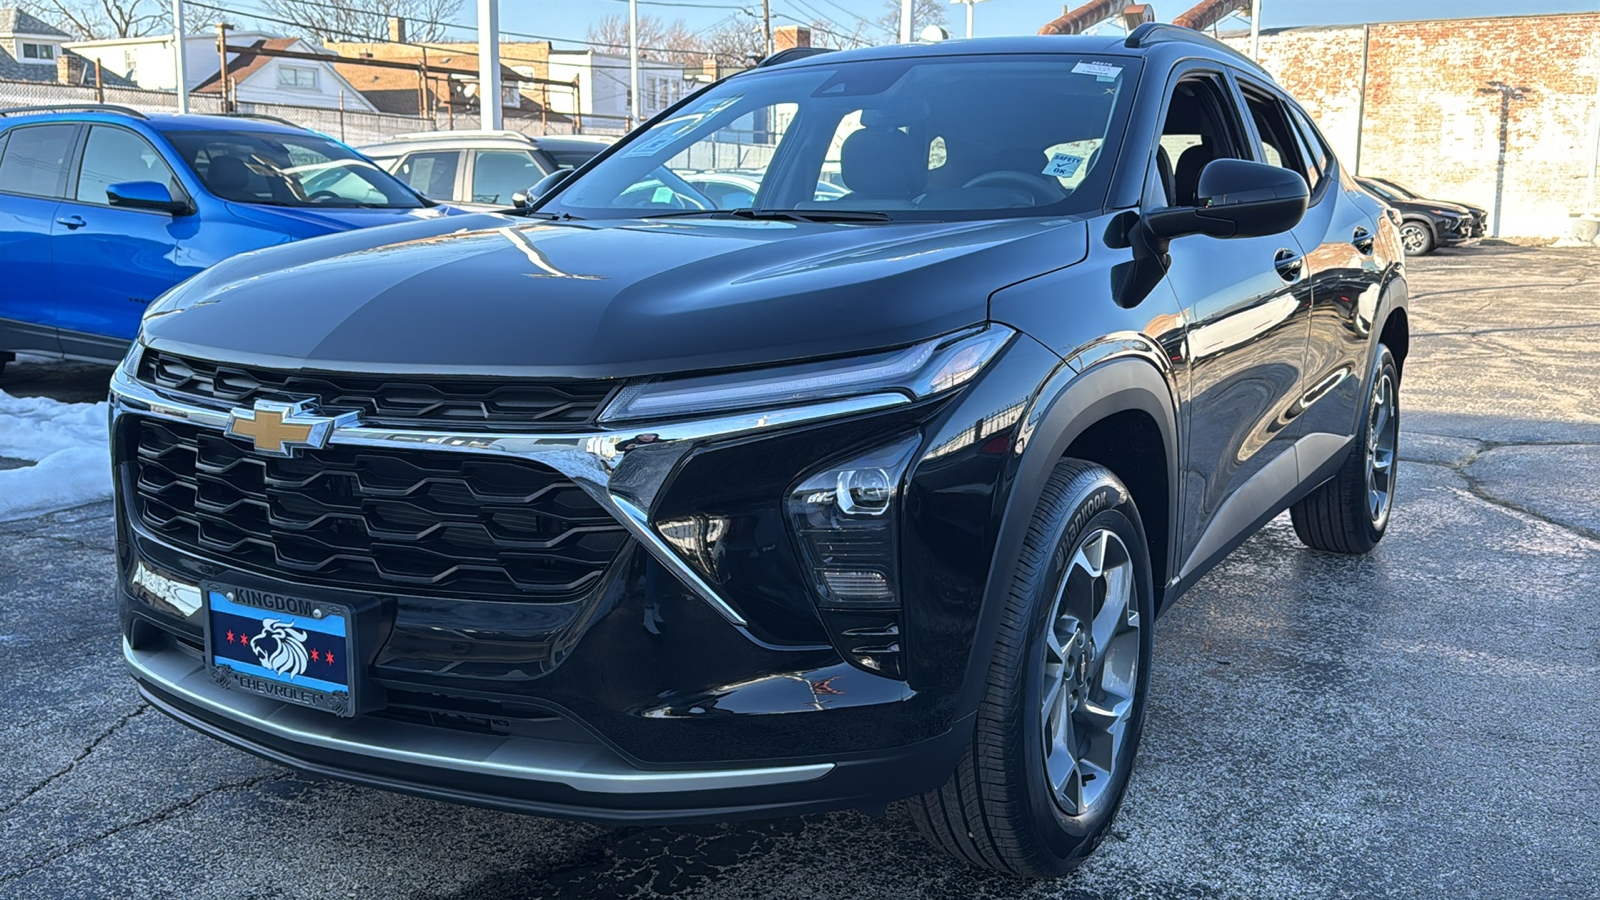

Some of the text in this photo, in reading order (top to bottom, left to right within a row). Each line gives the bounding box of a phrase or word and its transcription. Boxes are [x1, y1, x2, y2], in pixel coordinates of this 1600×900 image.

[1054, 154, 1081, 164] SAFETY
[1053, 167, 1067, 175] OK
[234, 587, 313, 617] KINGDOM
[239, 674, 318, 704] CHEVROLET
